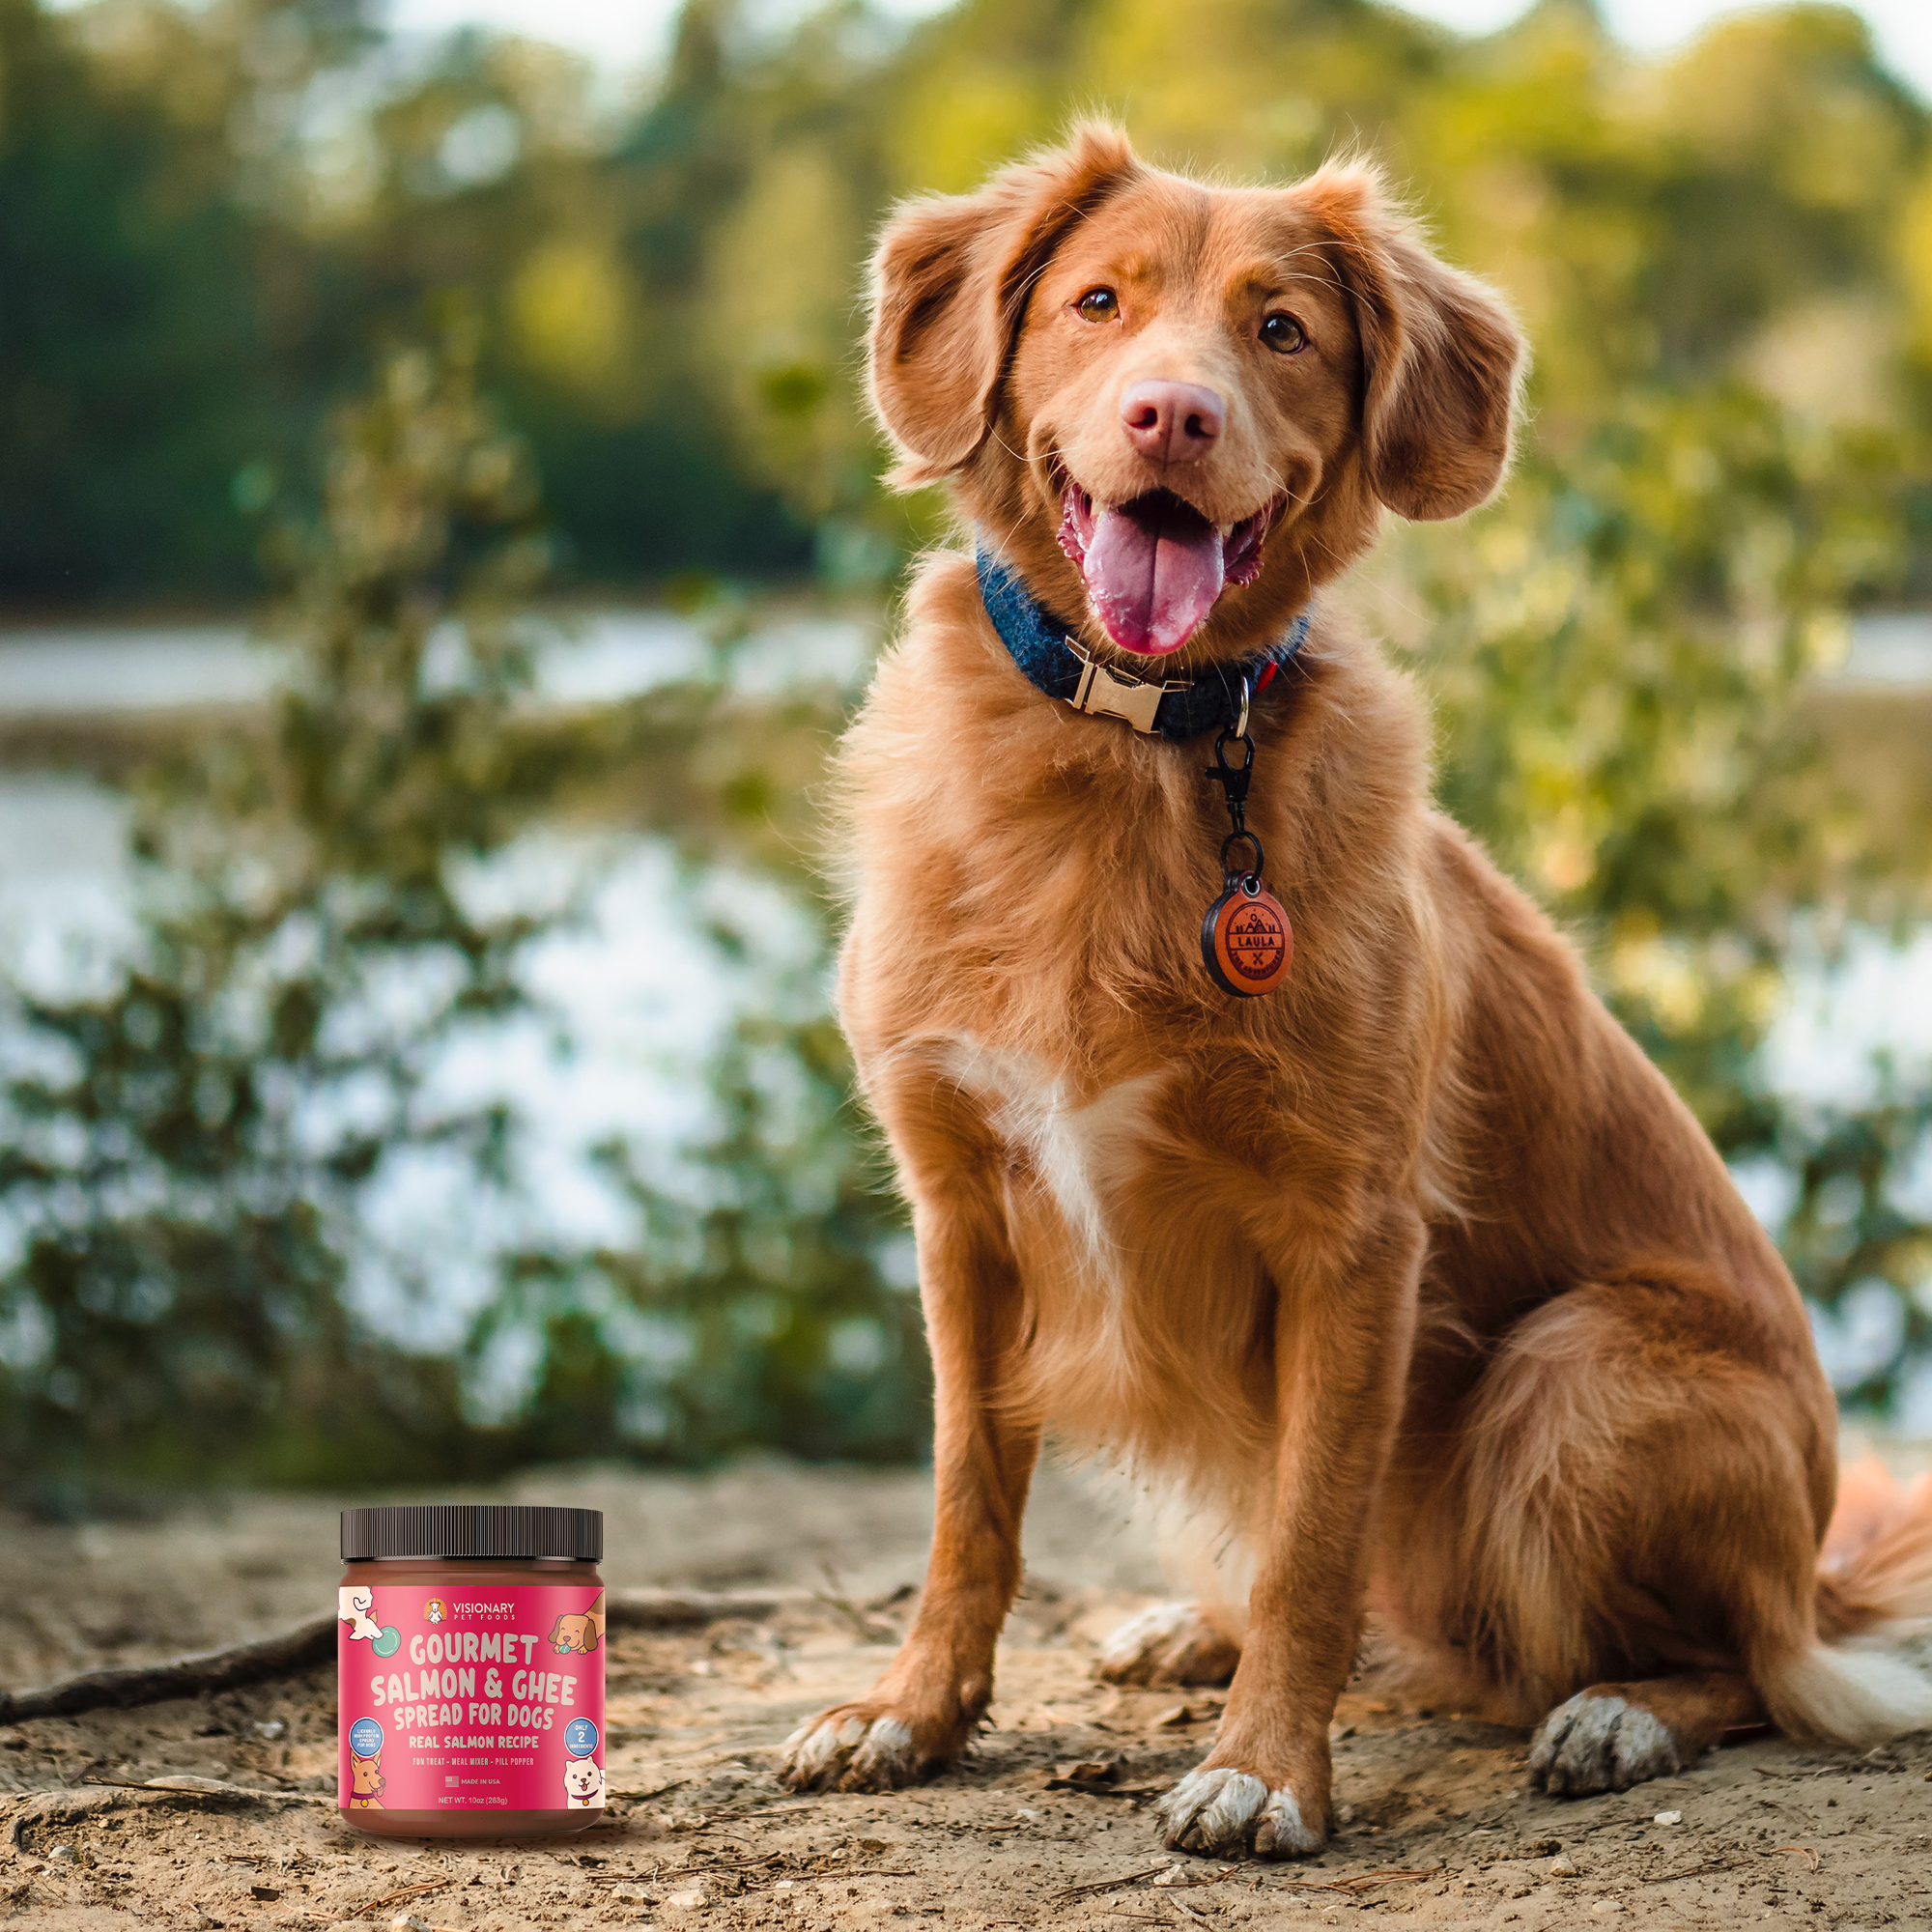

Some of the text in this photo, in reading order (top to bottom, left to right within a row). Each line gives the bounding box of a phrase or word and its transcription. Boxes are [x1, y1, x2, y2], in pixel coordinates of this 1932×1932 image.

[1238, 936, 1275, 947] LAULA
[453, 1603, 515, 1613] VISIONARY
[410, 1632, 539, 1665] GOURMET
[370, 1667, 578, 1706] SALMON & GHEE
[393, 1702, 554, 1730] SPREAD FOR DOGS
[409, 1735, 539, 1748] REAL SALMON RECIPE
[578, 1731, 585, 1743] 2
[412, 1757, 425, 1766] FUN
[426, 1757, 445, 1766] TREAT
[451, 1757, 468, 1766] MEAL
[469, 1757, 489, 1766] MIXER
[496, 1757, 509, 1766] PILL
[510, 1757, 534, 1766] POPPER
[486, 1796, 508, 1805] (283g)
